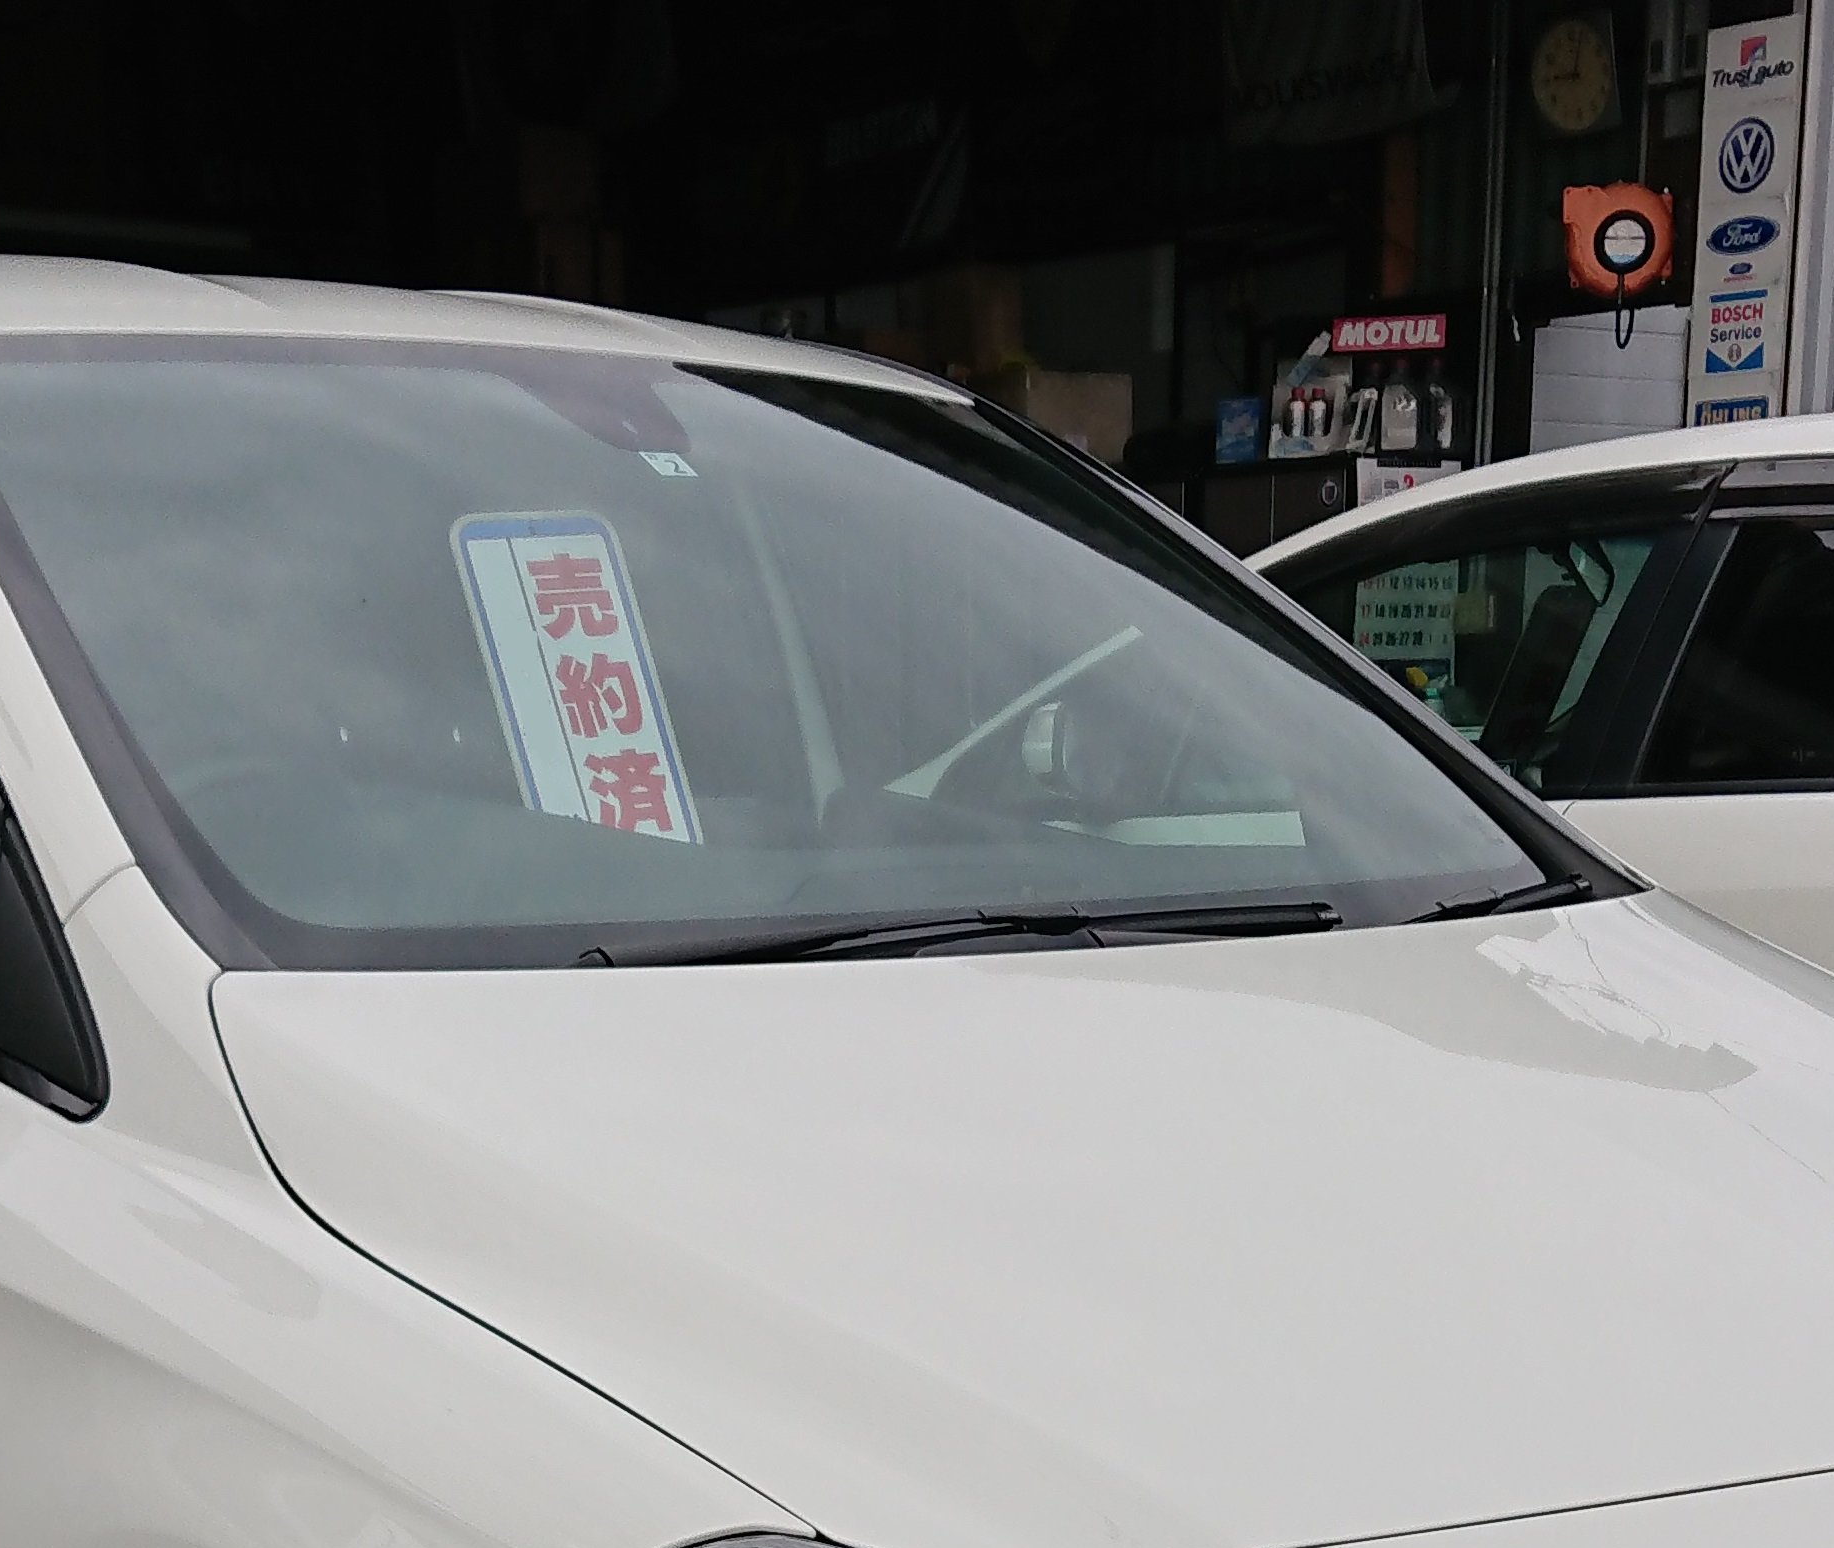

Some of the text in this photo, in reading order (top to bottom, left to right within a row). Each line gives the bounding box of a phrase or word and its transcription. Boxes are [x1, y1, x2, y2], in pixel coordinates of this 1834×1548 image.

[1722, 222, 1763, 248] Ford
[1710, 303, 1763, 325] BOSCH
[1338, 318, 1441, 347] MOTUL
[1709, 325, 1763, 344] Service
[525, 551, 674, 833] 売約済
